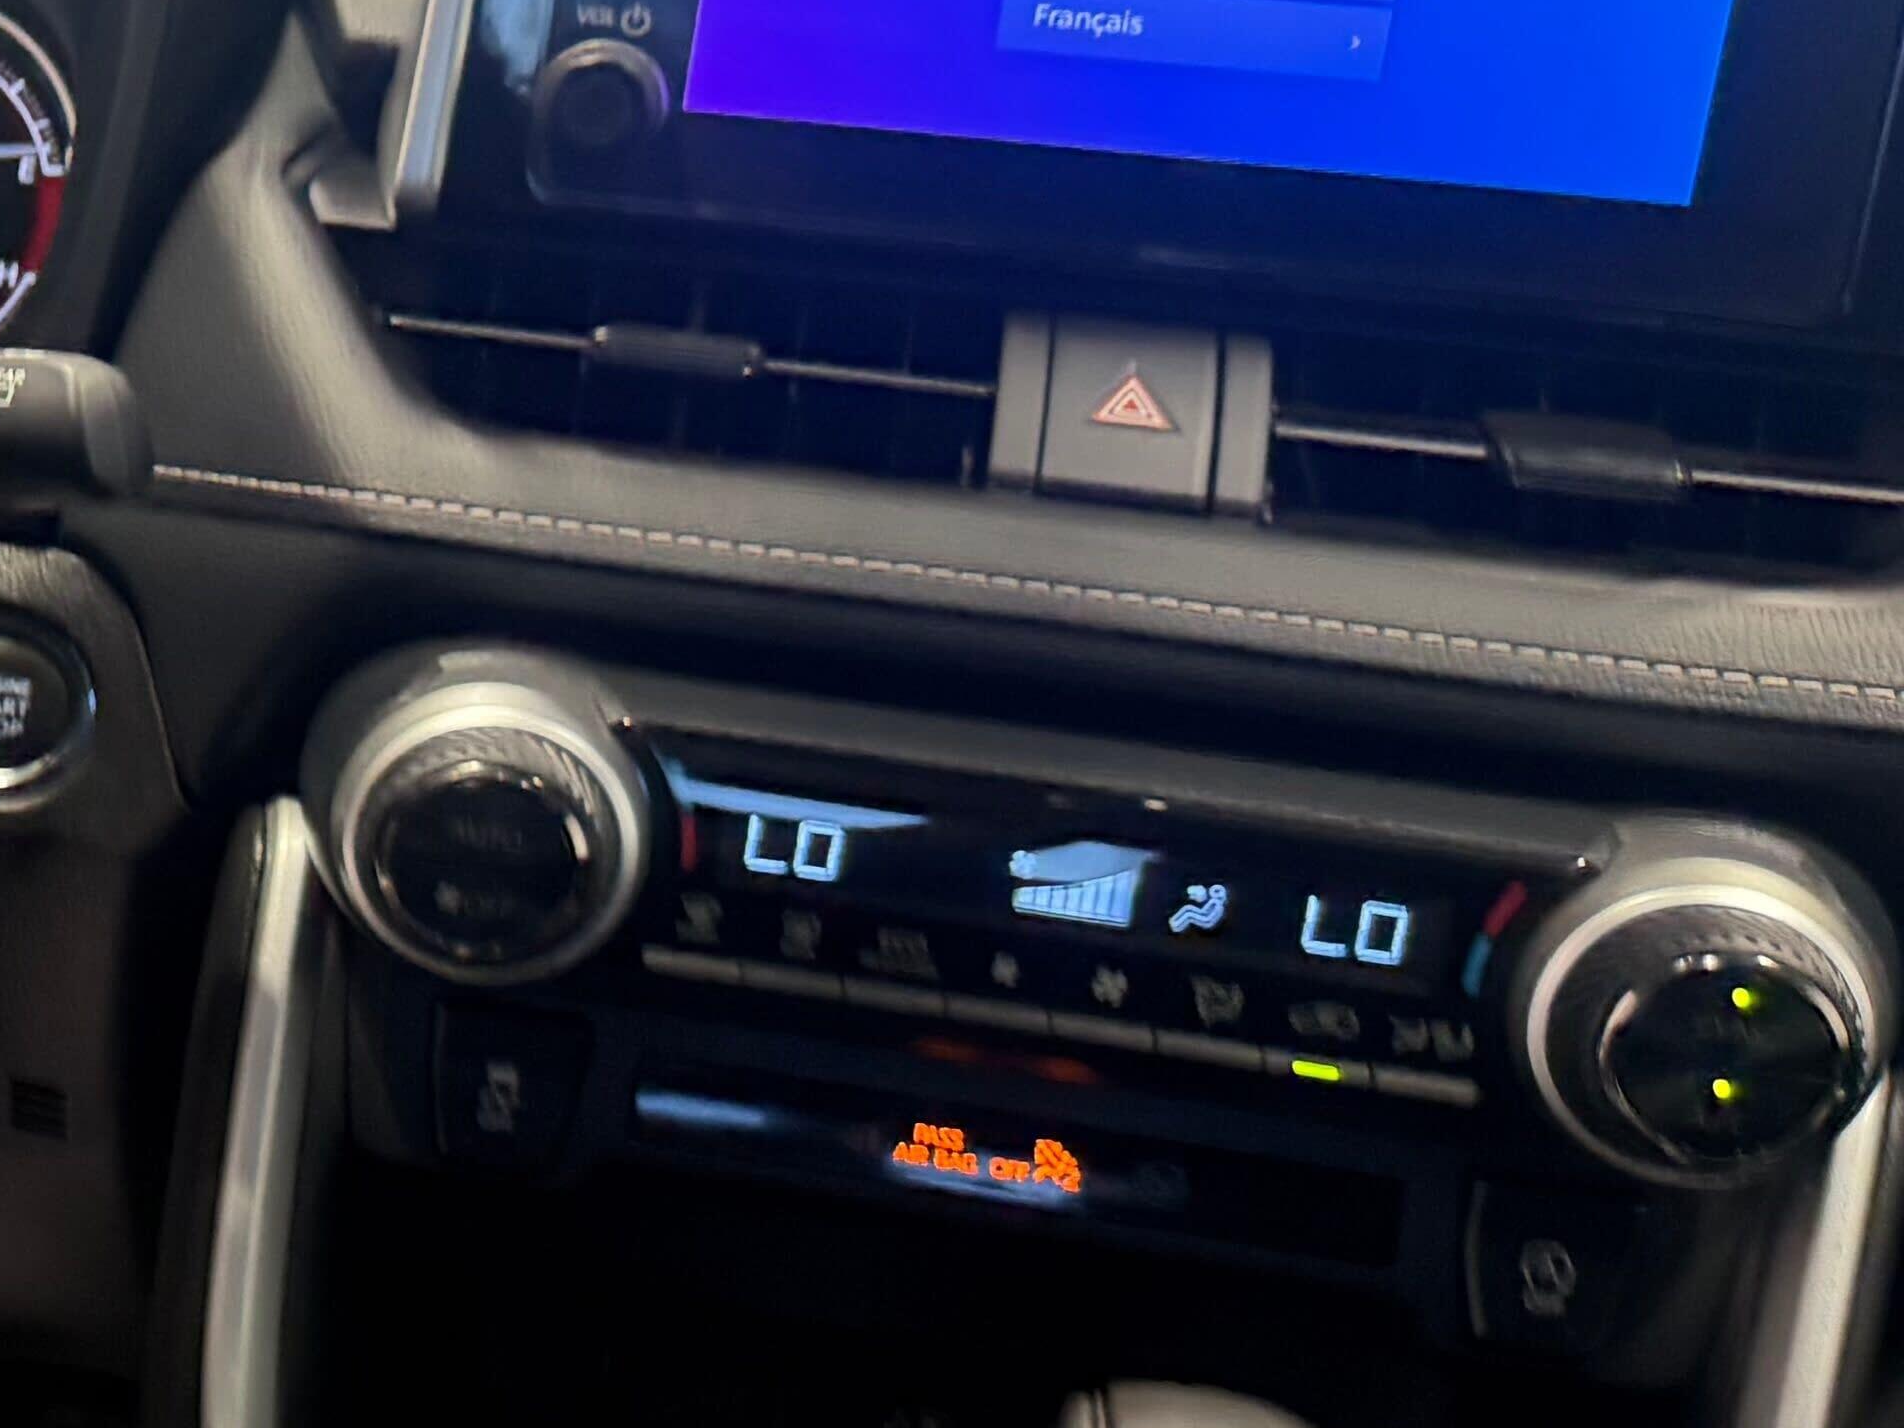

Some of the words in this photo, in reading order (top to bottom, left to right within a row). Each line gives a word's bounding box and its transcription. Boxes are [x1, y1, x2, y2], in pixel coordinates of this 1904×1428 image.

[1033, 3, 1145, 39] Français
[744, 813, 848, 883] LO
[1301, 894, 1410, 966] LO
[893, 1141, 930, 1167] AIR
[989, 1156, 1031, 1183] OFF
